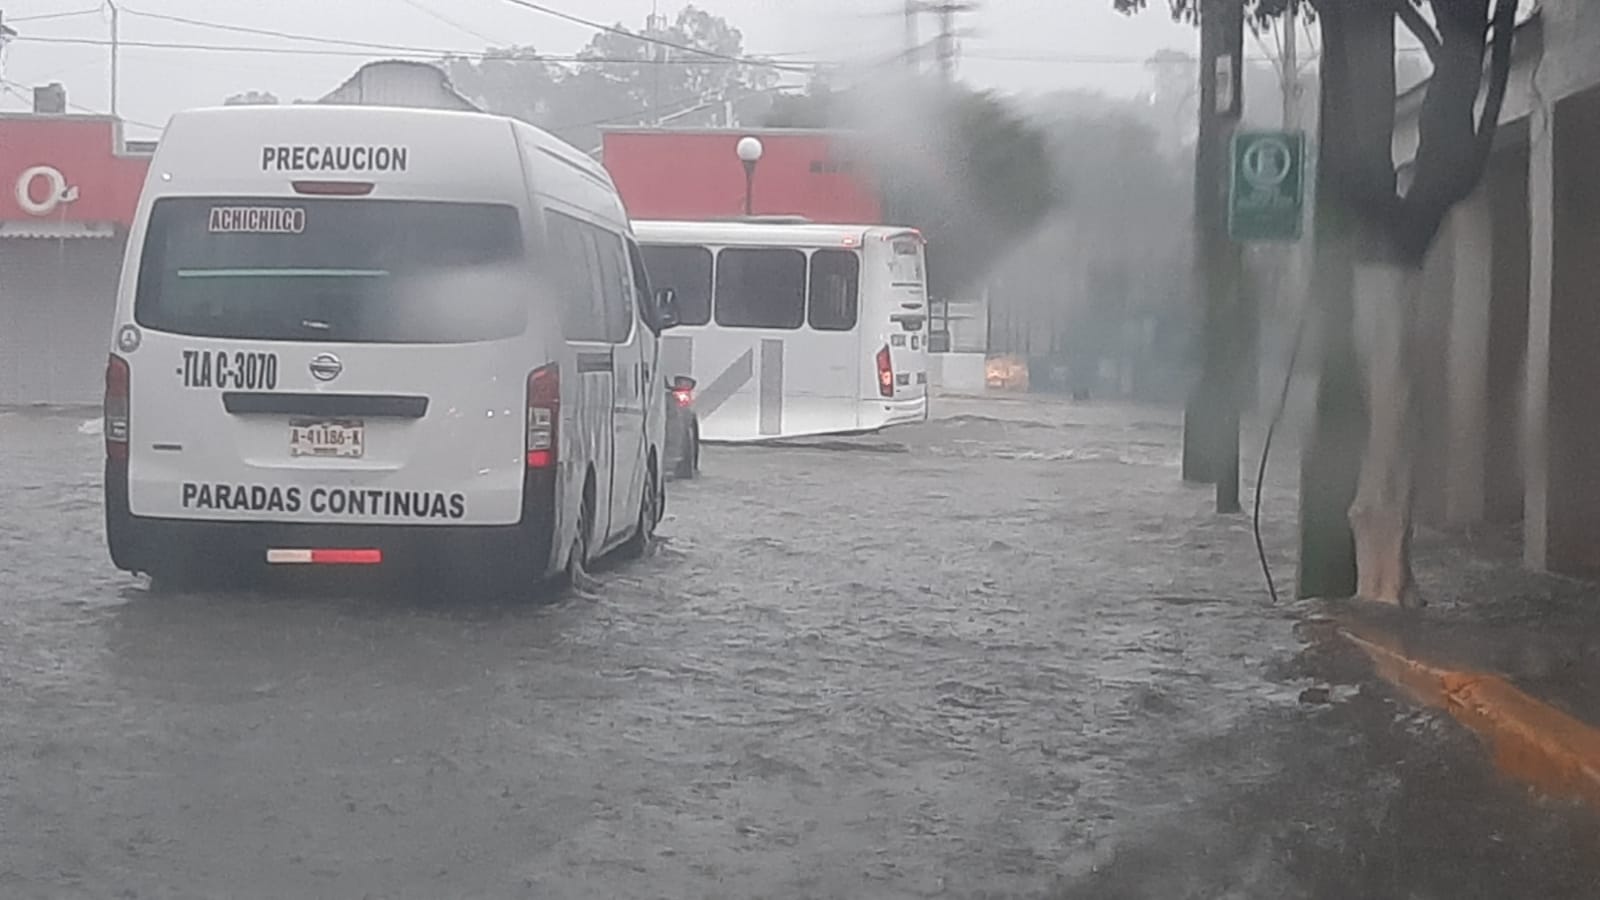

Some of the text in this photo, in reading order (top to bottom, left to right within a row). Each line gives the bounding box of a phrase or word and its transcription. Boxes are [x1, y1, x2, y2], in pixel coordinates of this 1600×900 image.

[262, 146, 407, 171] PRECAUCION
[209, 207, 305, 233] ACHICHILCO
[182, 483, 465, 518] PARADAS CONTINUAS
